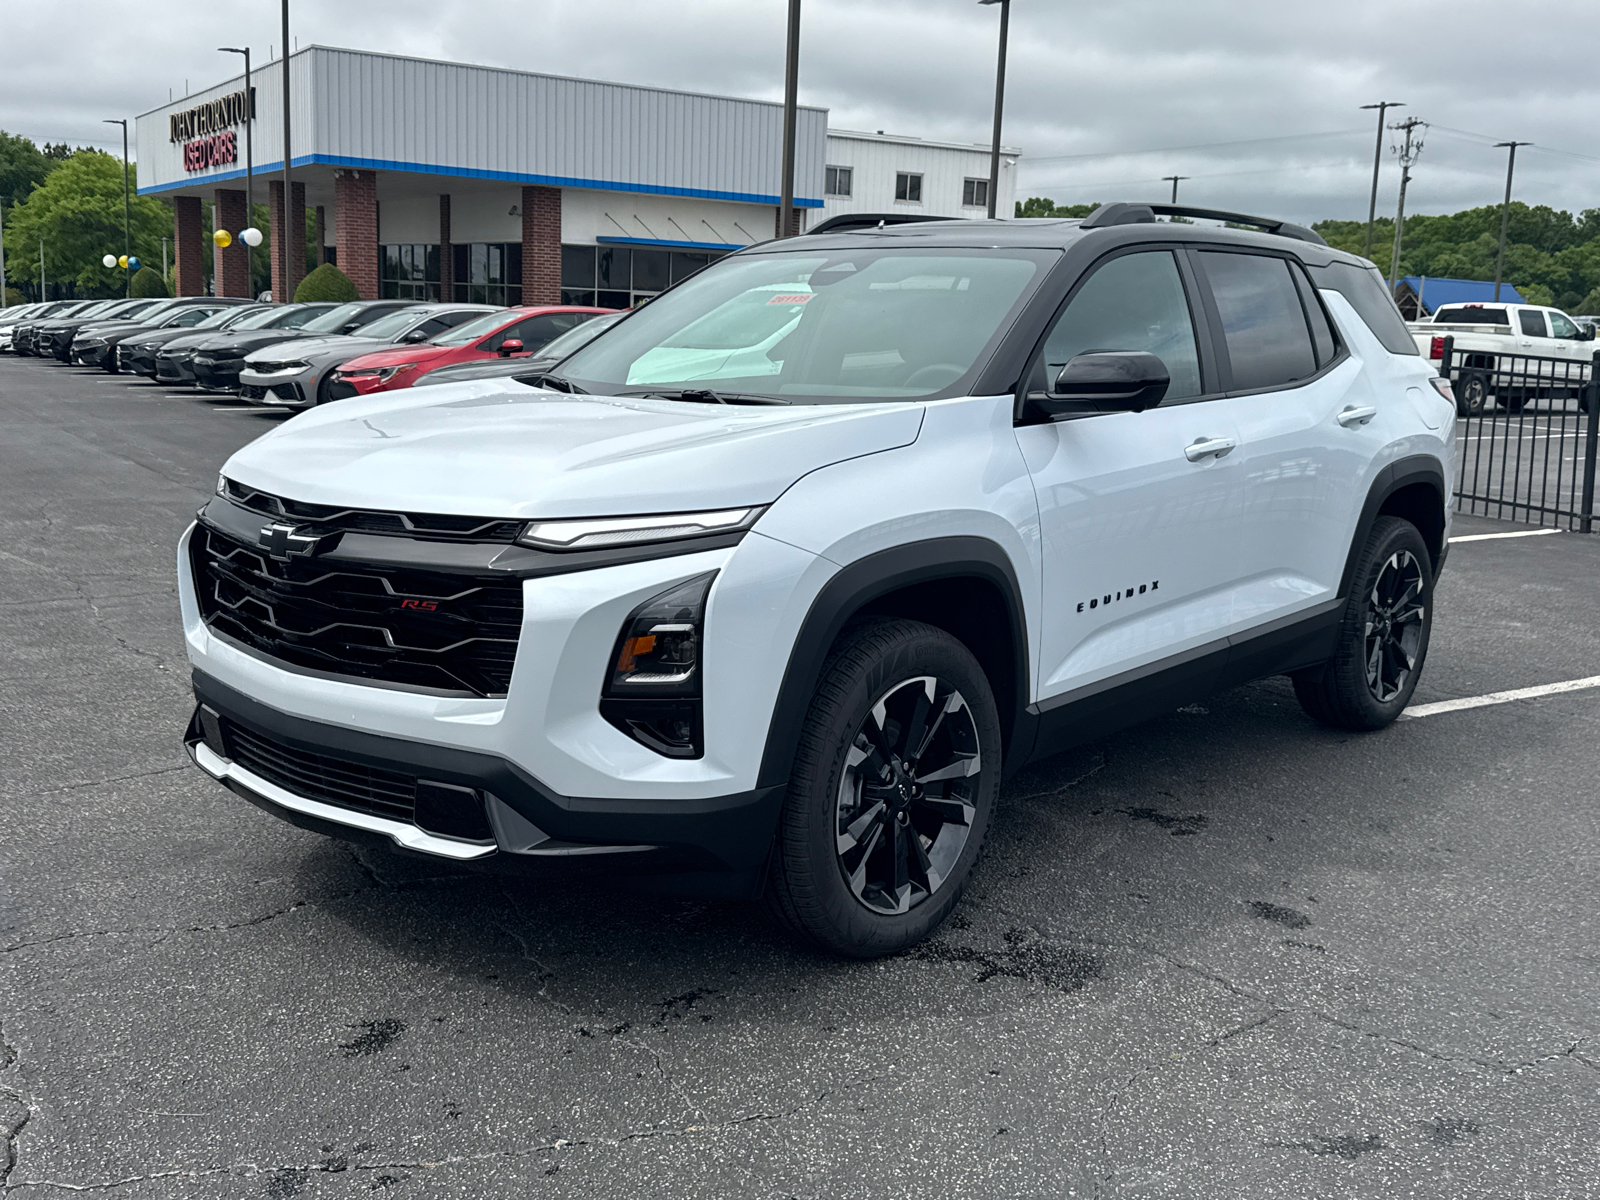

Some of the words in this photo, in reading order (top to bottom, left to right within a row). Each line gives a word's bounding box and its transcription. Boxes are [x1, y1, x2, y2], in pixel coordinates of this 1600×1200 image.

[169, 109, 195, 143] JOHN
[183, 139, 208, 172] USED
[207, 131, 238, 167] CARS
[401, 599, 440, 612] RS
[1076, 580, 1159, 613] EQUINOX
